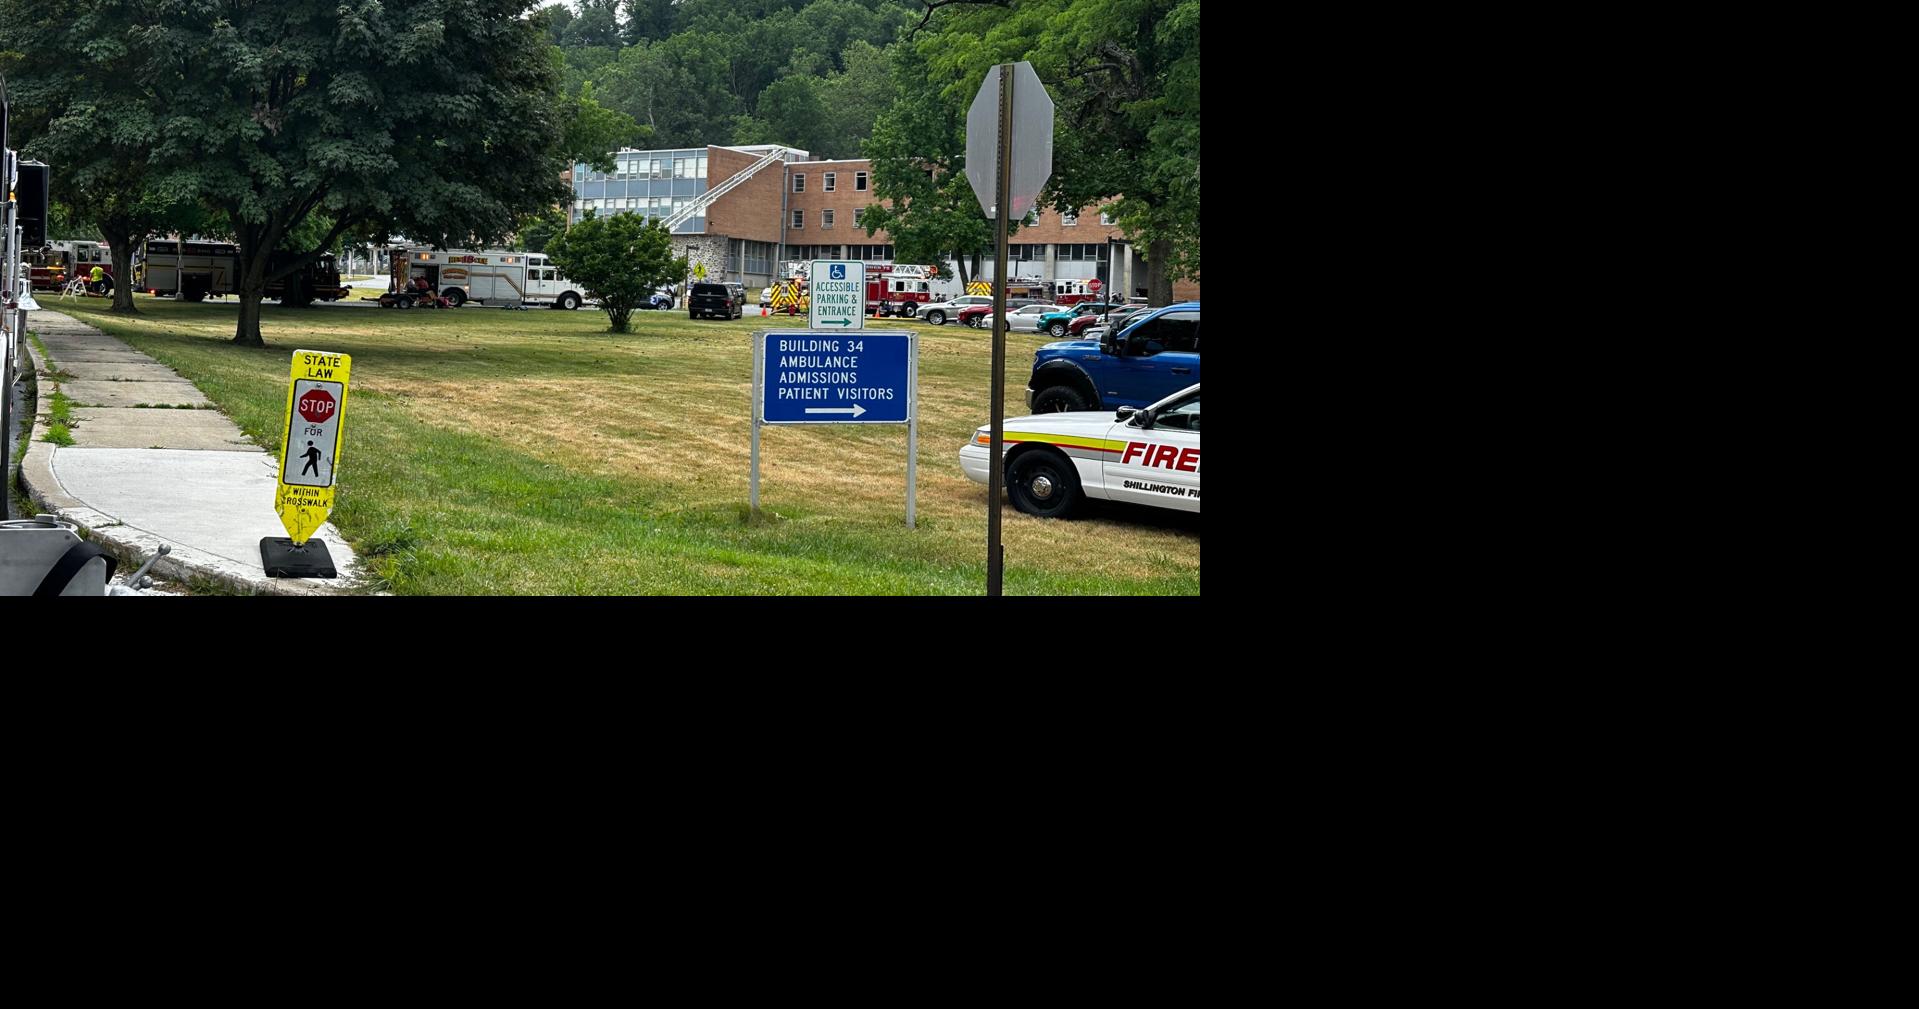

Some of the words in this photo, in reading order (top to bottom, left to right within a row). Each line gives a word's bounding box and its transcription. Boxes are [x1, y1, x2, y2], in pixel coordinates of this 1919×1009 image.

[815, 281, 860, 292] ACCESSIBLE
[816, 293, 849, 304] PARKING
[851, 294, 857, 304] &
[817, 305, 856, 316] ENTRANCE
[779, 339, 840, 352] BUILDING
[847, 340, 864, 352] 34
[304, 354, 341, 367] STATE
[779, 355, 858, 368] AMBULANCE
[308, 367, 333, 379] LAW
[779, 371, 857, 384] ADMISSIONS
[778, 387, 829, 400] PATIENT
[837, 387, 894, 400] VISITORS
[300, 399, 334, 414] STOP
[304, 427, 323, 437] FOR
[1122, 441, 1200, 472] FIRE
[293, 487, 320, 497] WITHIN
[1123, 480, 1186, 496] SHILLINGTON
